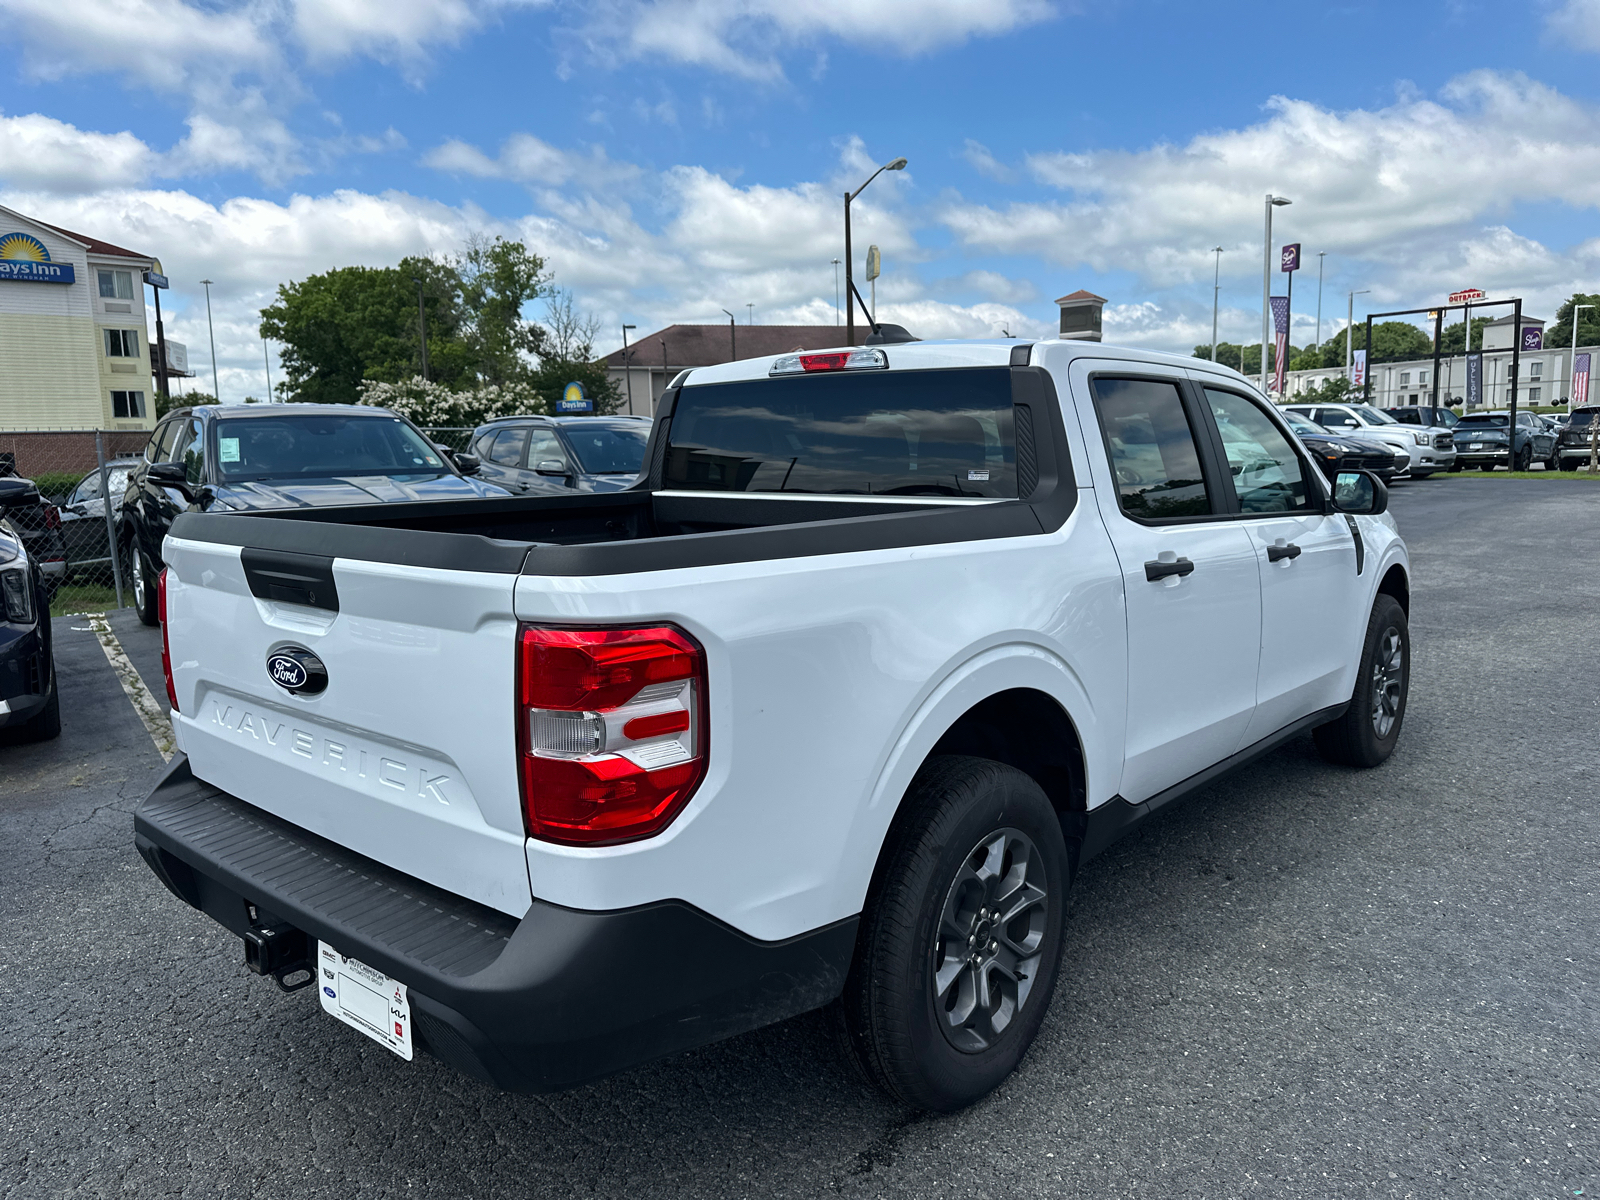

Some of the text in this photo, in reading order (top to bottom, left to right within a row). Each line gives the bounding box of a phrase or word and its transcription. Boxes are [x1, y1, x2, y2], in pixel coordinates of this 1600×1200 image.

[0, 262, 61, 276] ays Inn
[1448, 293, 1482, 302] OUTBACK
[562, 401, 577, 409] Days
[273, 659, 298, 683] Ford
[212, 700, 450, 805] MAVERICK
[322, 950, 336, 960] GMC
[390, 1007, 406, 1021] KIA
